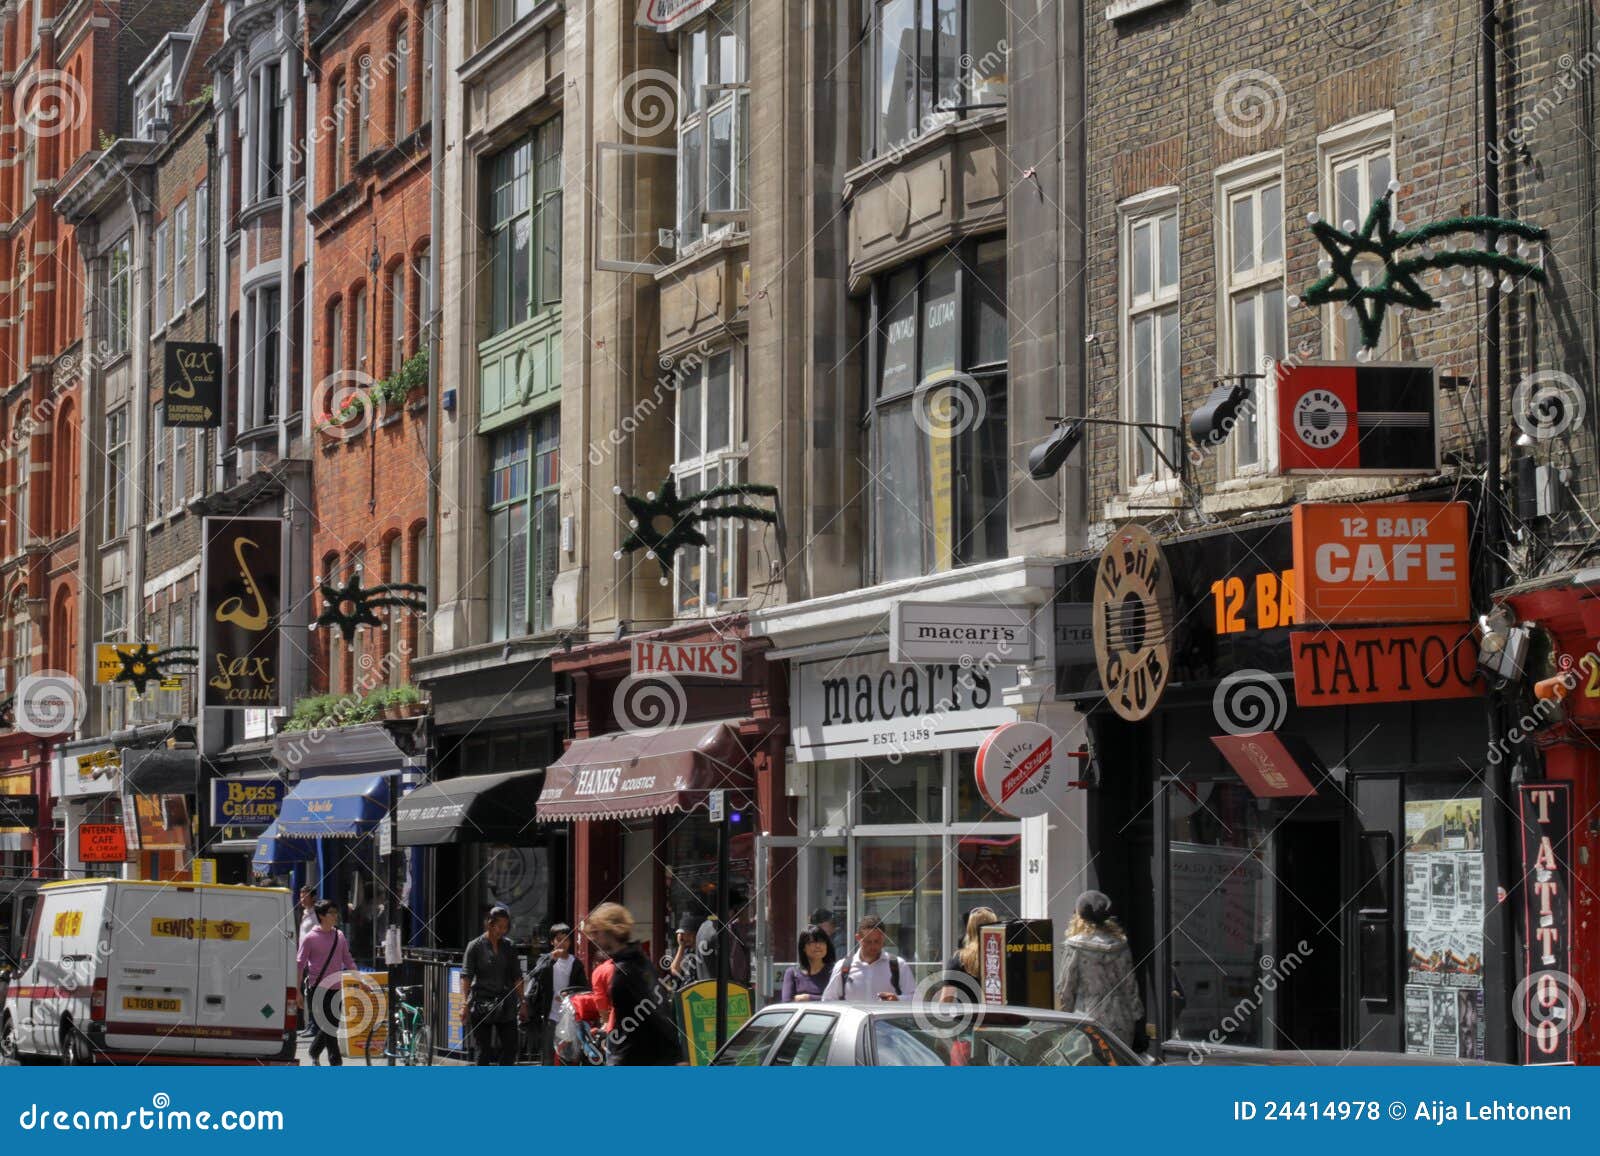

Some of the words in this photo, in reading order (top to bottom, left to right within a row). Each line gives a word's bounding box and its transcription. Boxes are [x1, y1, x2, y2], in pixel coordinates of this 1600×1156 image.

[929, 301, 955, 328] GUITAR
[1300, 398, 1311, 410] 12
[1314, 393, 1339, 410] BAR
[1302, 429, 1340, 445] CLUB
[1340, 518, 1368, 537] 12
[1376, 518, 1428, 537] BAR
[1102, 555, 1122, 598] 12
[1124, 548, 1161, 595] BAR
[1315, 543, 1457, 582] CAFE
[1211, 576, 1246, 634] 12
[1256, 568, 1295, 630] BA
[918, 625, 1015, 641] macari's
[209, 653, 275, 690] Sax
[636, 642, 738, 676] HANK'S
[1299, 633, 1481, 697] TATTOO
[1106, 650, 1163, 711] CLUB
[873, 733, 897, 745] EST.
[903, 730, 930, 742] 1958
[228, 783, 276, 802] BASS
[575, 767, 622, 795] HANKS
[620, 776, 656, 791] ACOUSTICS
[223, 800, 279, 818] CELLAR
[157, 918, 194, 939] LEWIS
[1531, 790, 1559, 1054] TATTOO
[1006, 944, 1024, 952] PAY
[1027, 944, 1052, 952] HERE
